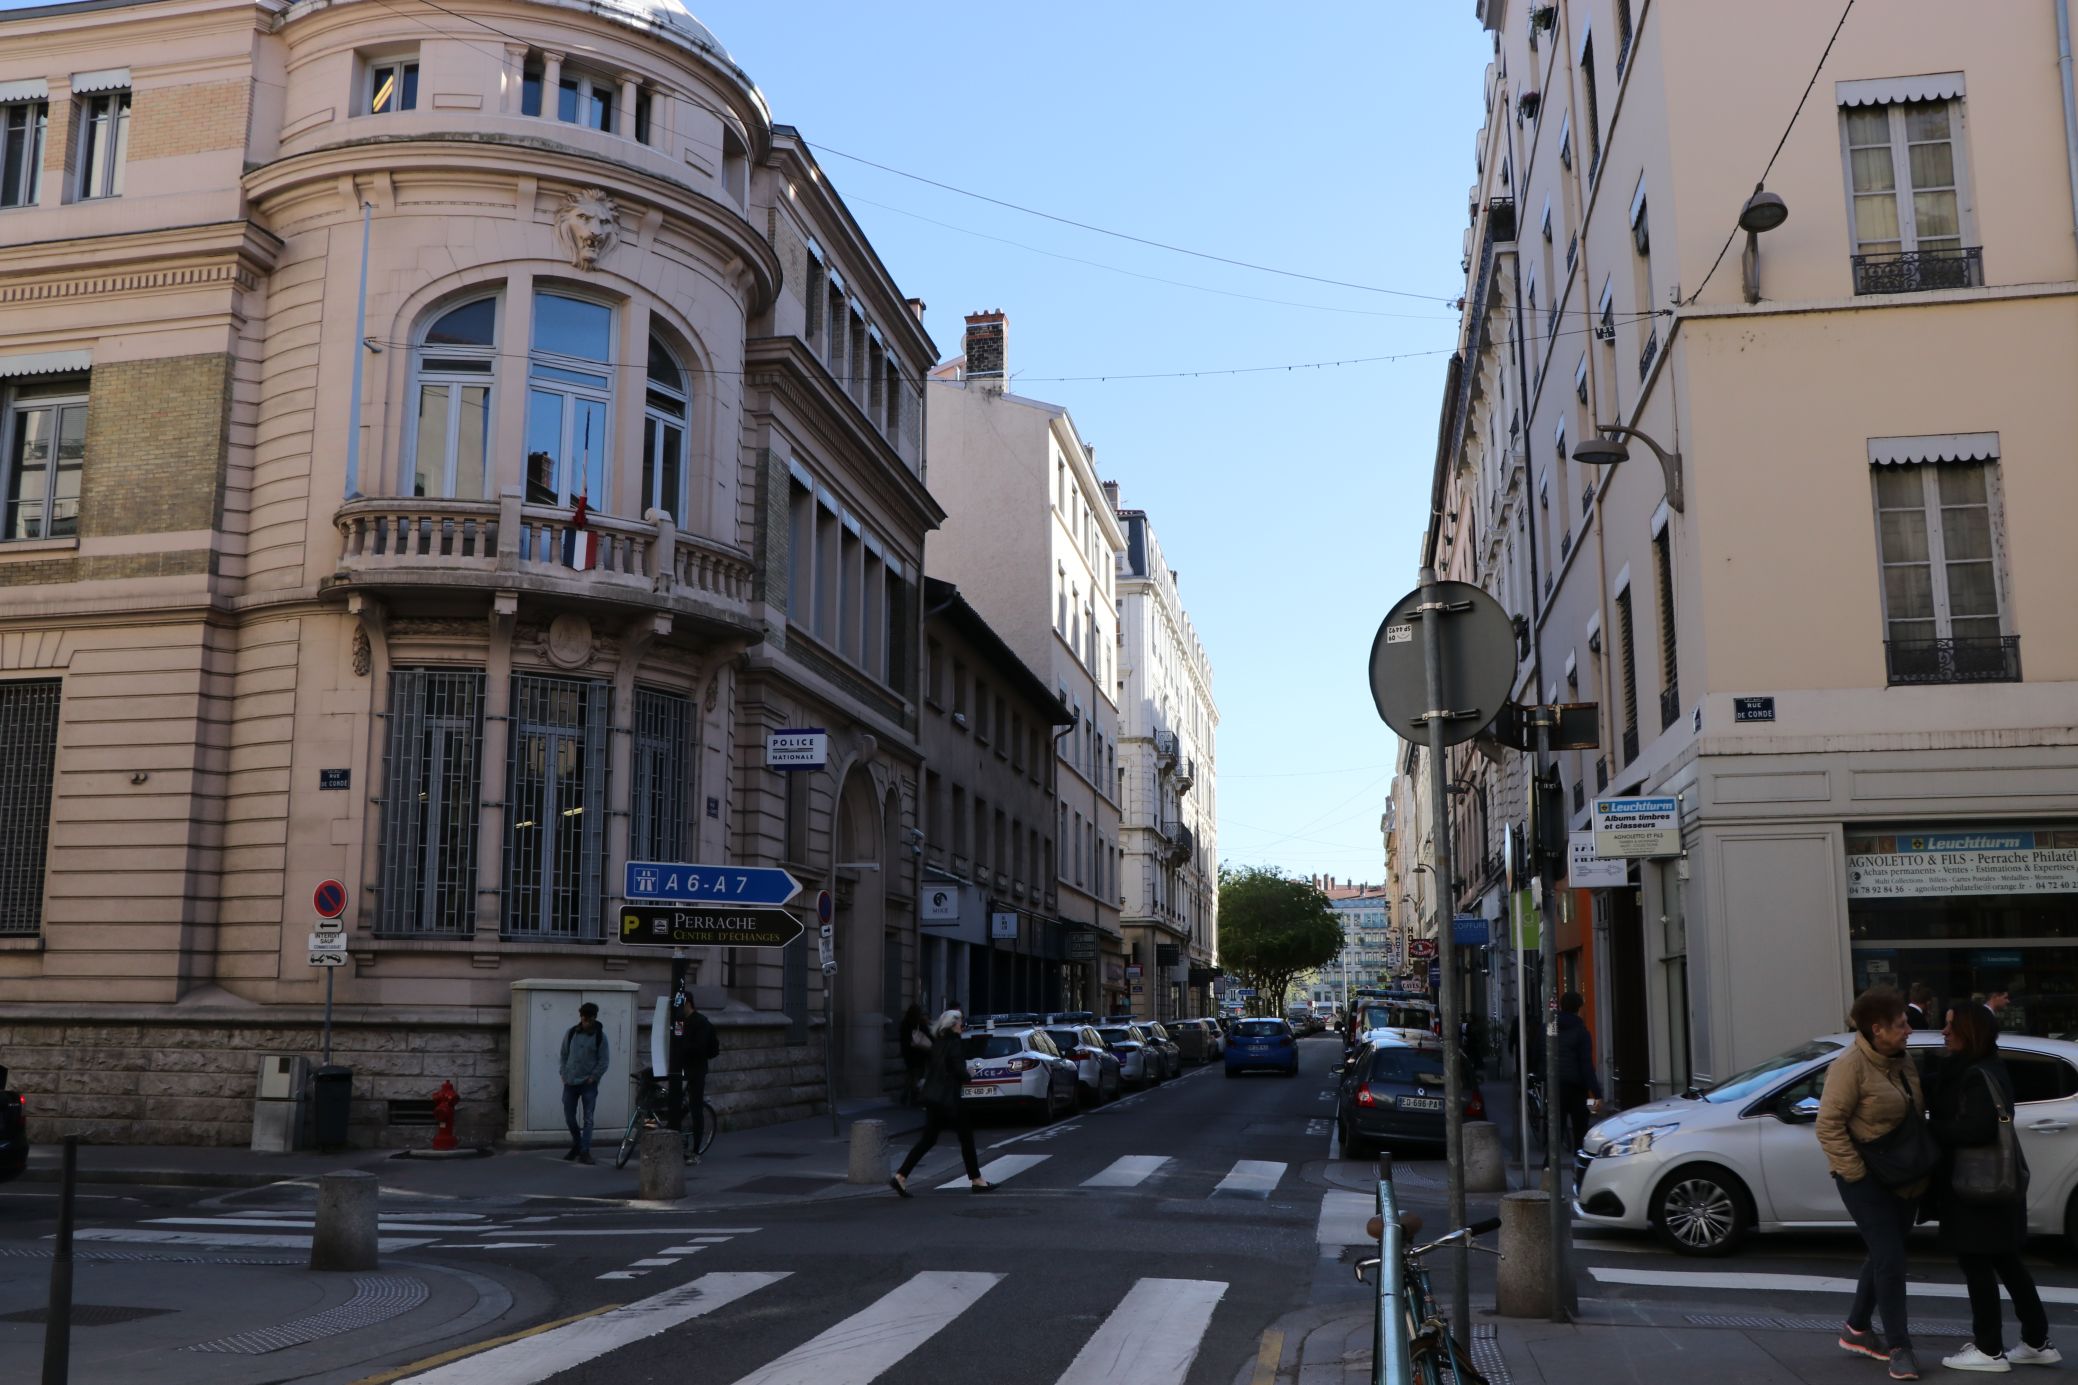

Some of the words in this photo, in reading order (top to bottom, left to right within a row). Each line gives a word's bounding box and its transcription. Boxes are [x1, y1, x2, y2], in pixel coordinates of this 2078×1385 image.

[773, 738, 814, 746] POLICE
[1610, 801, 1673, 812] Leuchtturm
[1604, 814, 1636, 822] Albums
[1638, 813, 1671, 821] timbres
[1615, 822, 1656, 830] classeurs
[1927, 836, 2021, 850] Leuchtturm
[1848, 855, 1925, 868] AGNOLETTO
[1927, 854, 1937, 865] &
[1941, 853, 1967, 865] FILS
[1978, 852, 2029, 864] Perrache
[1863, 868, 1888, 877] Achats
[1890, 867, 1937, 878] permanents
[1943, 865, 1969, 874] Ventes
[1976, 864, 2022, 873] Estimations
[2024, 864, 2031, 872] &
[2033, 863, 2075, 873] Expertises
[1849, 886, 1859, 894] 04
[1861, 886, 1871, 894] 78
[1872, 886, 1882, 894] 92
[1895, 885, 1905, 893] 36
[2035, 881, 2046, 889] 04
[2048, 881, 2058, 889] 72
[2060, 881, 2071, 889] 40
[623, 915, 640, 935] P
[673, 912, 757, 931] PERRACHE
[1453, 921, 1488, 930] COIFFURE
[673, 929, 714, 942] CENTRE
